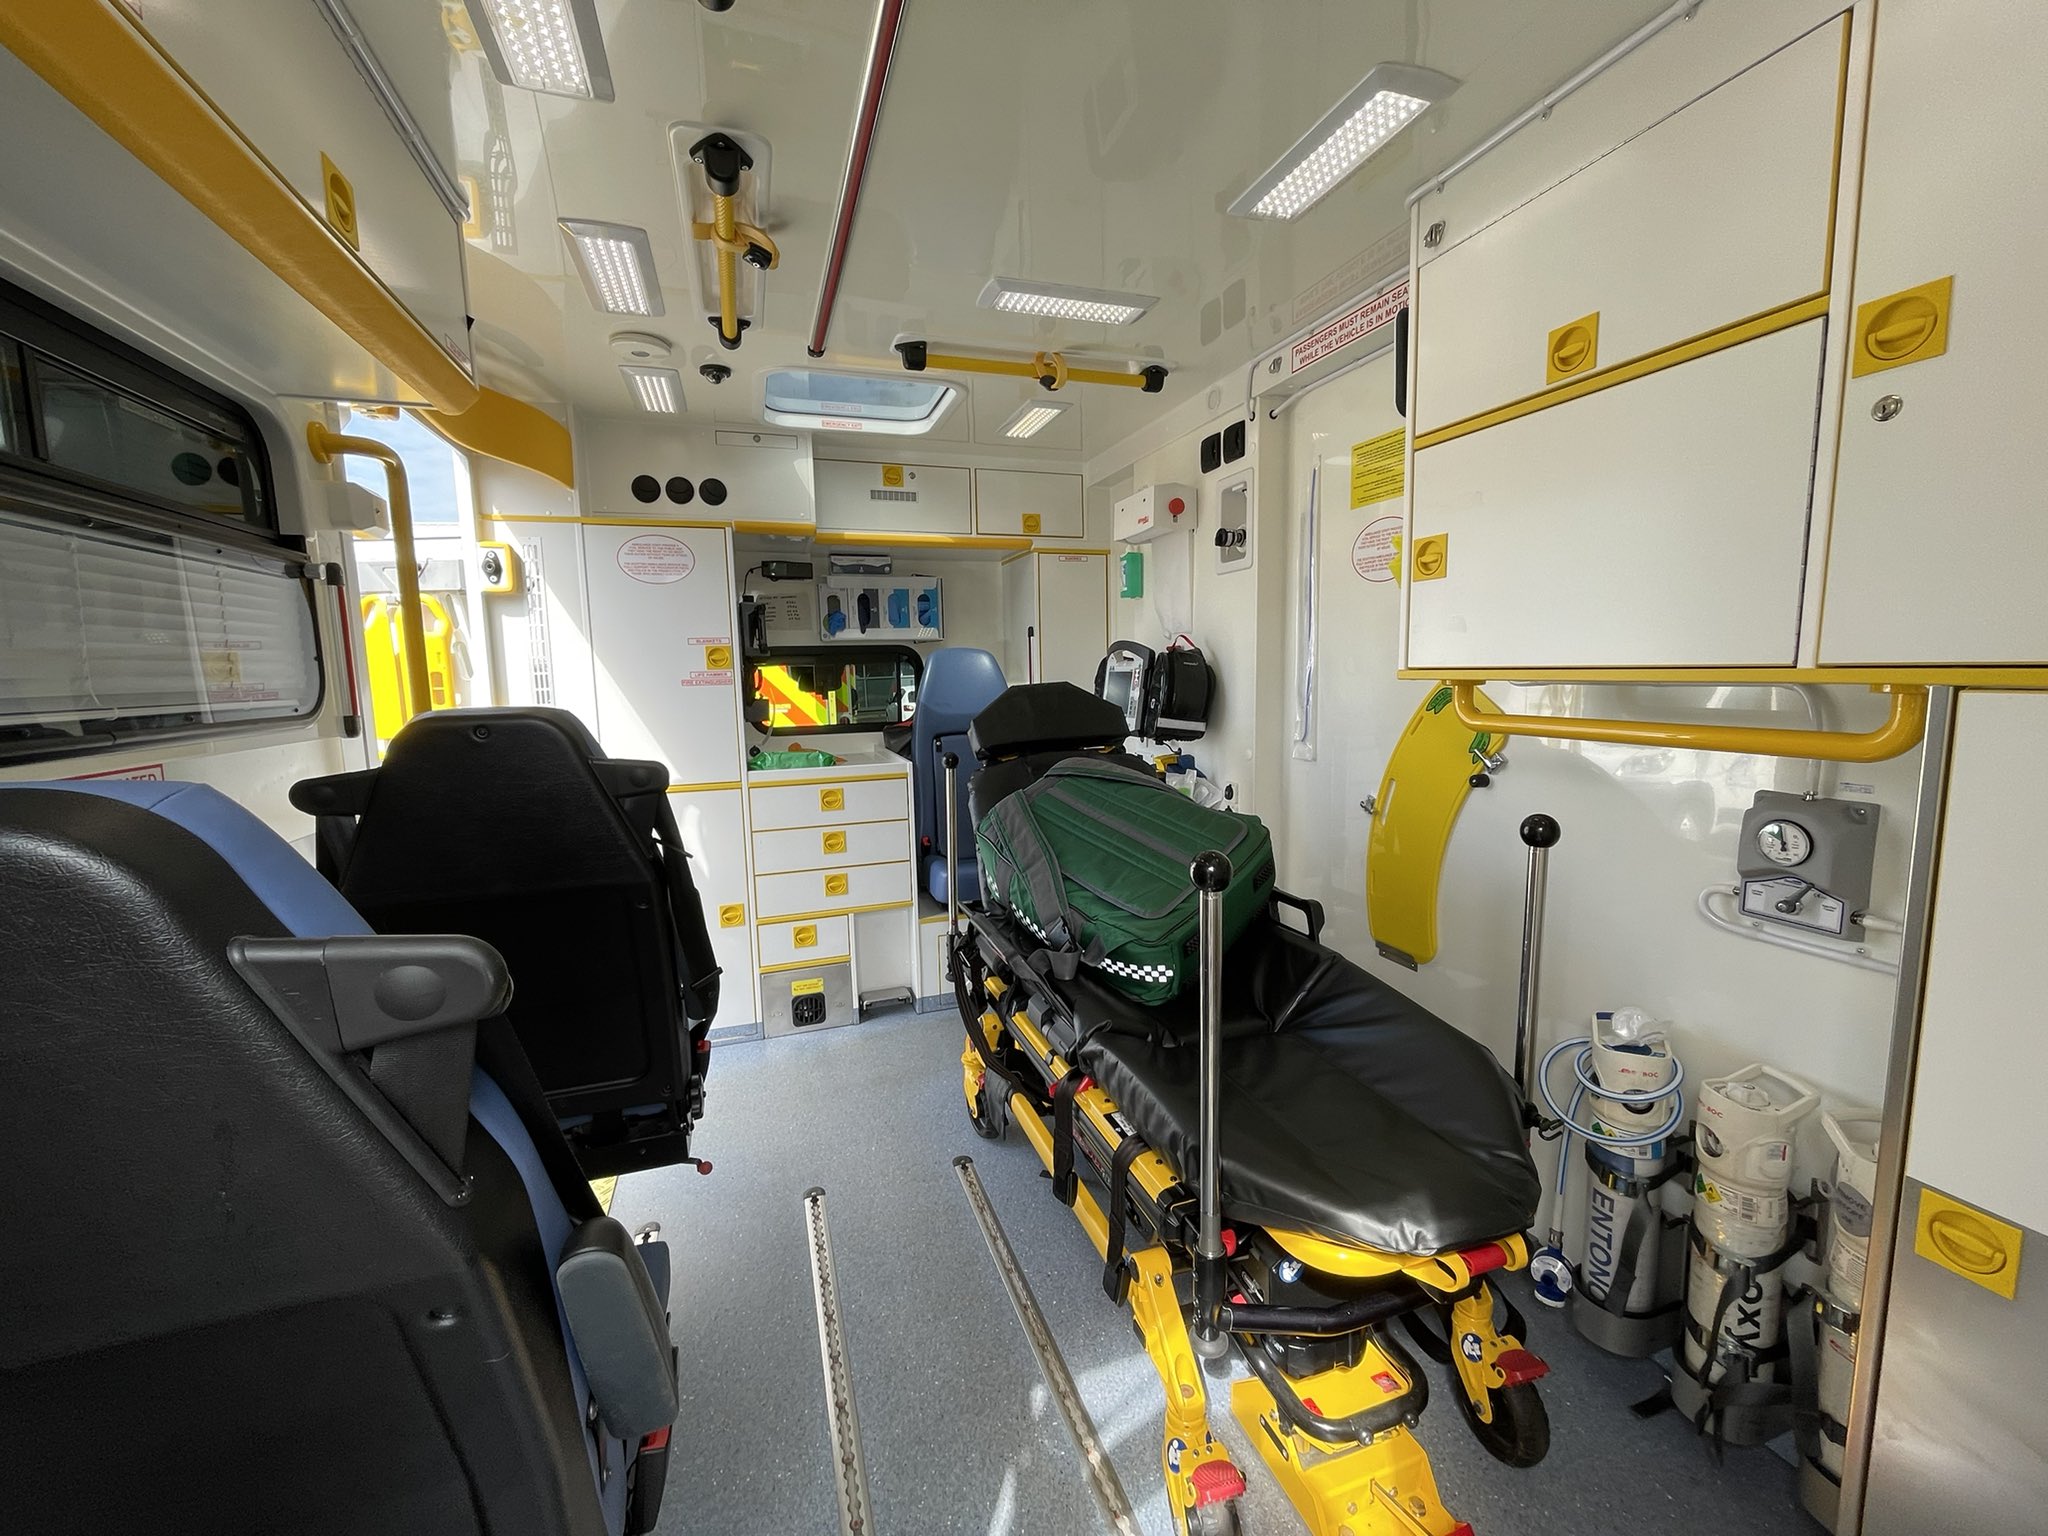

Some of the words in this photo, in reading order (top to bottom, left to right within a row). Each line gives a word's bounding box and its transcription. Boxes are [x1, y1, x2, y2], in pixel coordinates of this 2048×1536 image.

[1295, 327, 1338, 357] PASSENGERS
[1339, 315, 1359, 333] MUST
[1360, 296, 1390, 319] REMAIN
[1391, 285, 1409, 302] SEA
[1299, 348, 1319, 365] WHILE
[1320, 342, 1334, 354] THE
[1334, 322, 1365, 348] VEHICLE
[1366, 317, 1374, 328] IS
[1375, 312, 1384, 324] IN
[1588, 1185, 1615, 1302] ENTONO
[1724, 1281, 1763, 1349] oxy
